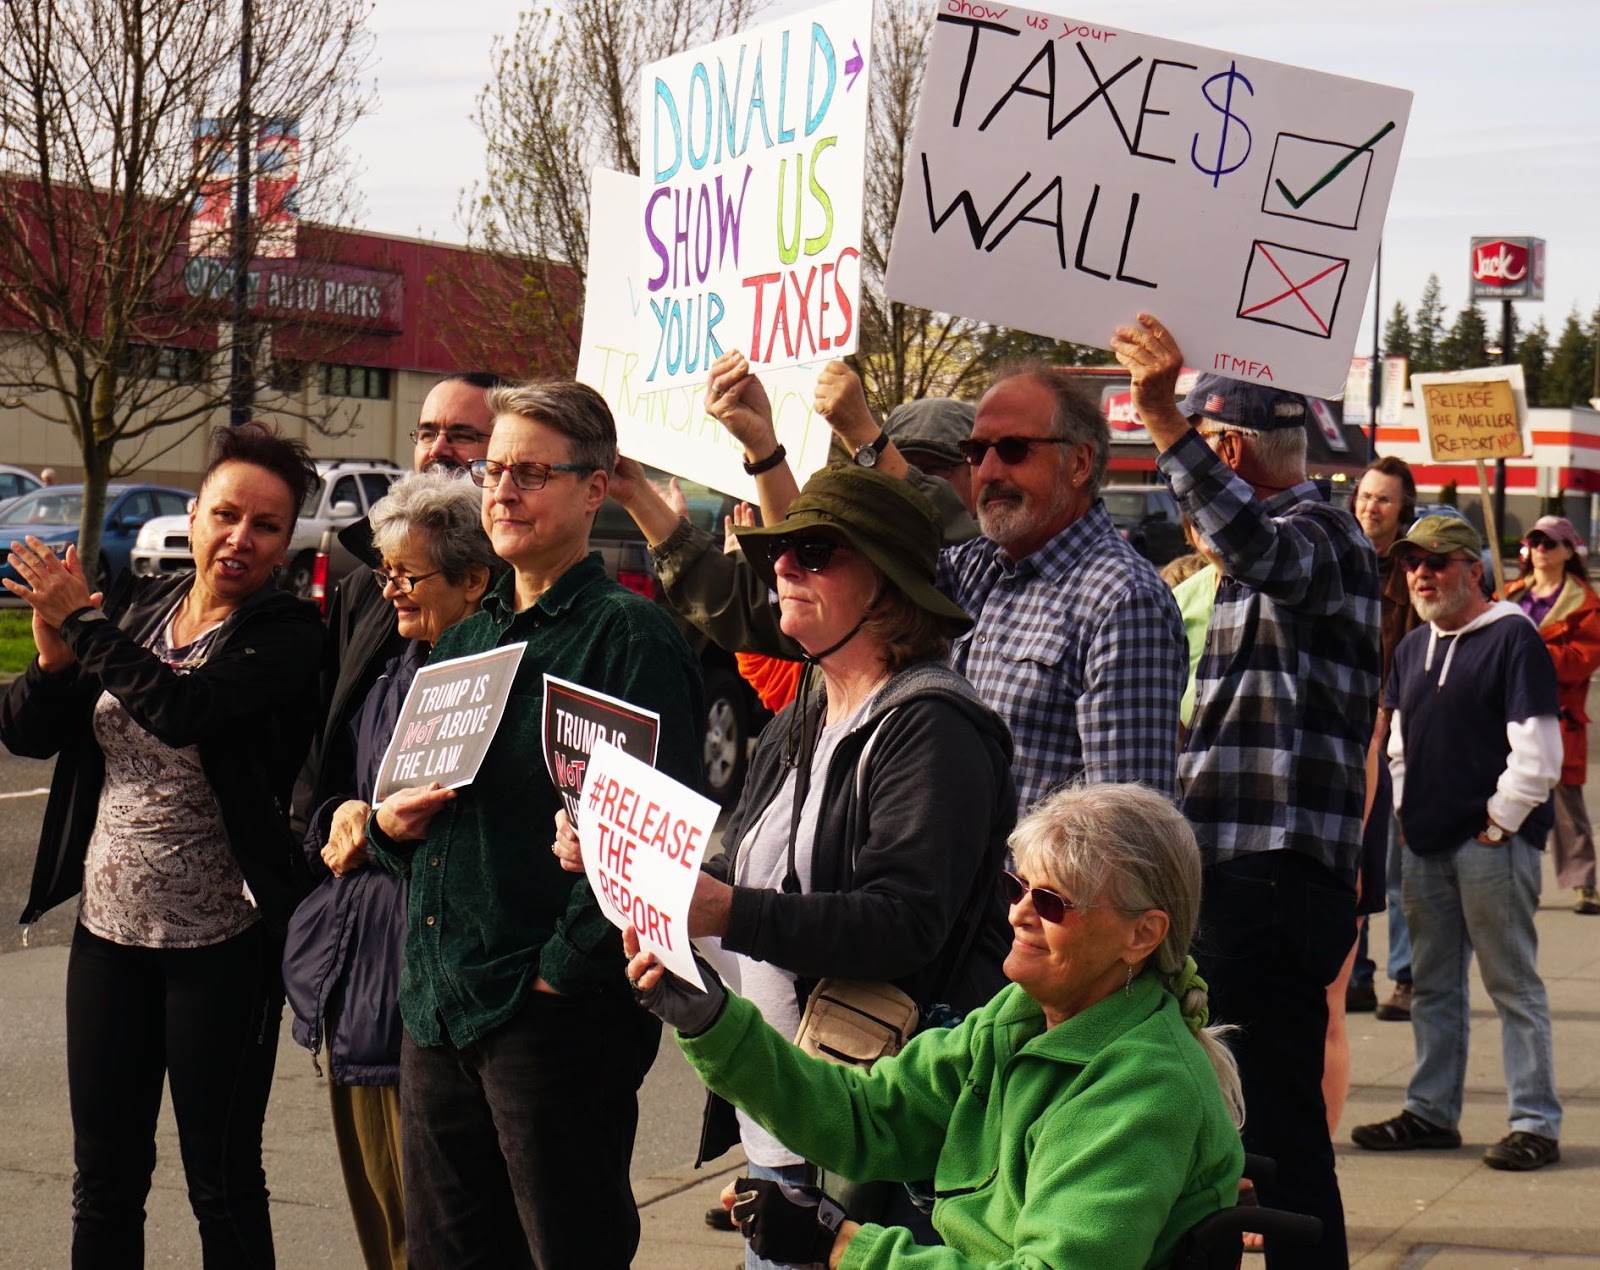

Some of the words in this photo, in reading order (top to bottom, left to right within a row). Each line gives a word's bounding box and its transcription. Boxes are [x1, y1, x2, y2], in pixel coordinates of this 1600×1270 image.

[948, 0, 1009, 20] Show
[1026, 15, 1049, 30] us
[1058, 23, 1117, 43] your
[654, 22, 837, 184] DONALD
[936, 13, 1254, 188] TAXE$
[645, 165, 753, 292] SHOW
[777, 136, 837, 265] US
[921, 152, 1157, 288] WALL
[1473, 244, 1527, 280] Jack
[268, 272, 320, 311] AUTO
[324, 280, 380, 318] PARTS
[646, 292, 725, 382] YOUR
[742, 247, 860, 364] TAXES
[1213, 353, 1274, 381] ITMFA
[1425, 388, 1494, 408] RELEASE
[1432, 414, 1452, 426] THE
[1456, 413, 1515, 433] MUELLER
[1434, 434, 1495, 453] REPORT
[417, 679, 471, 714] TRUMP
[470, 674, 490, 703] IS
[437, 704, 492, 740] ABOVE
[556, 708, 606, 756] TRUMP
[392, 751, 424, 781] THE
[424, 744, 463, 776] LAW.
[562, 791, 580, 825] TH
[588, 773, 702, 870] #RELEASE
[598, 822, 637, 882] THE
[599, 868, 673, 952] REPORT
